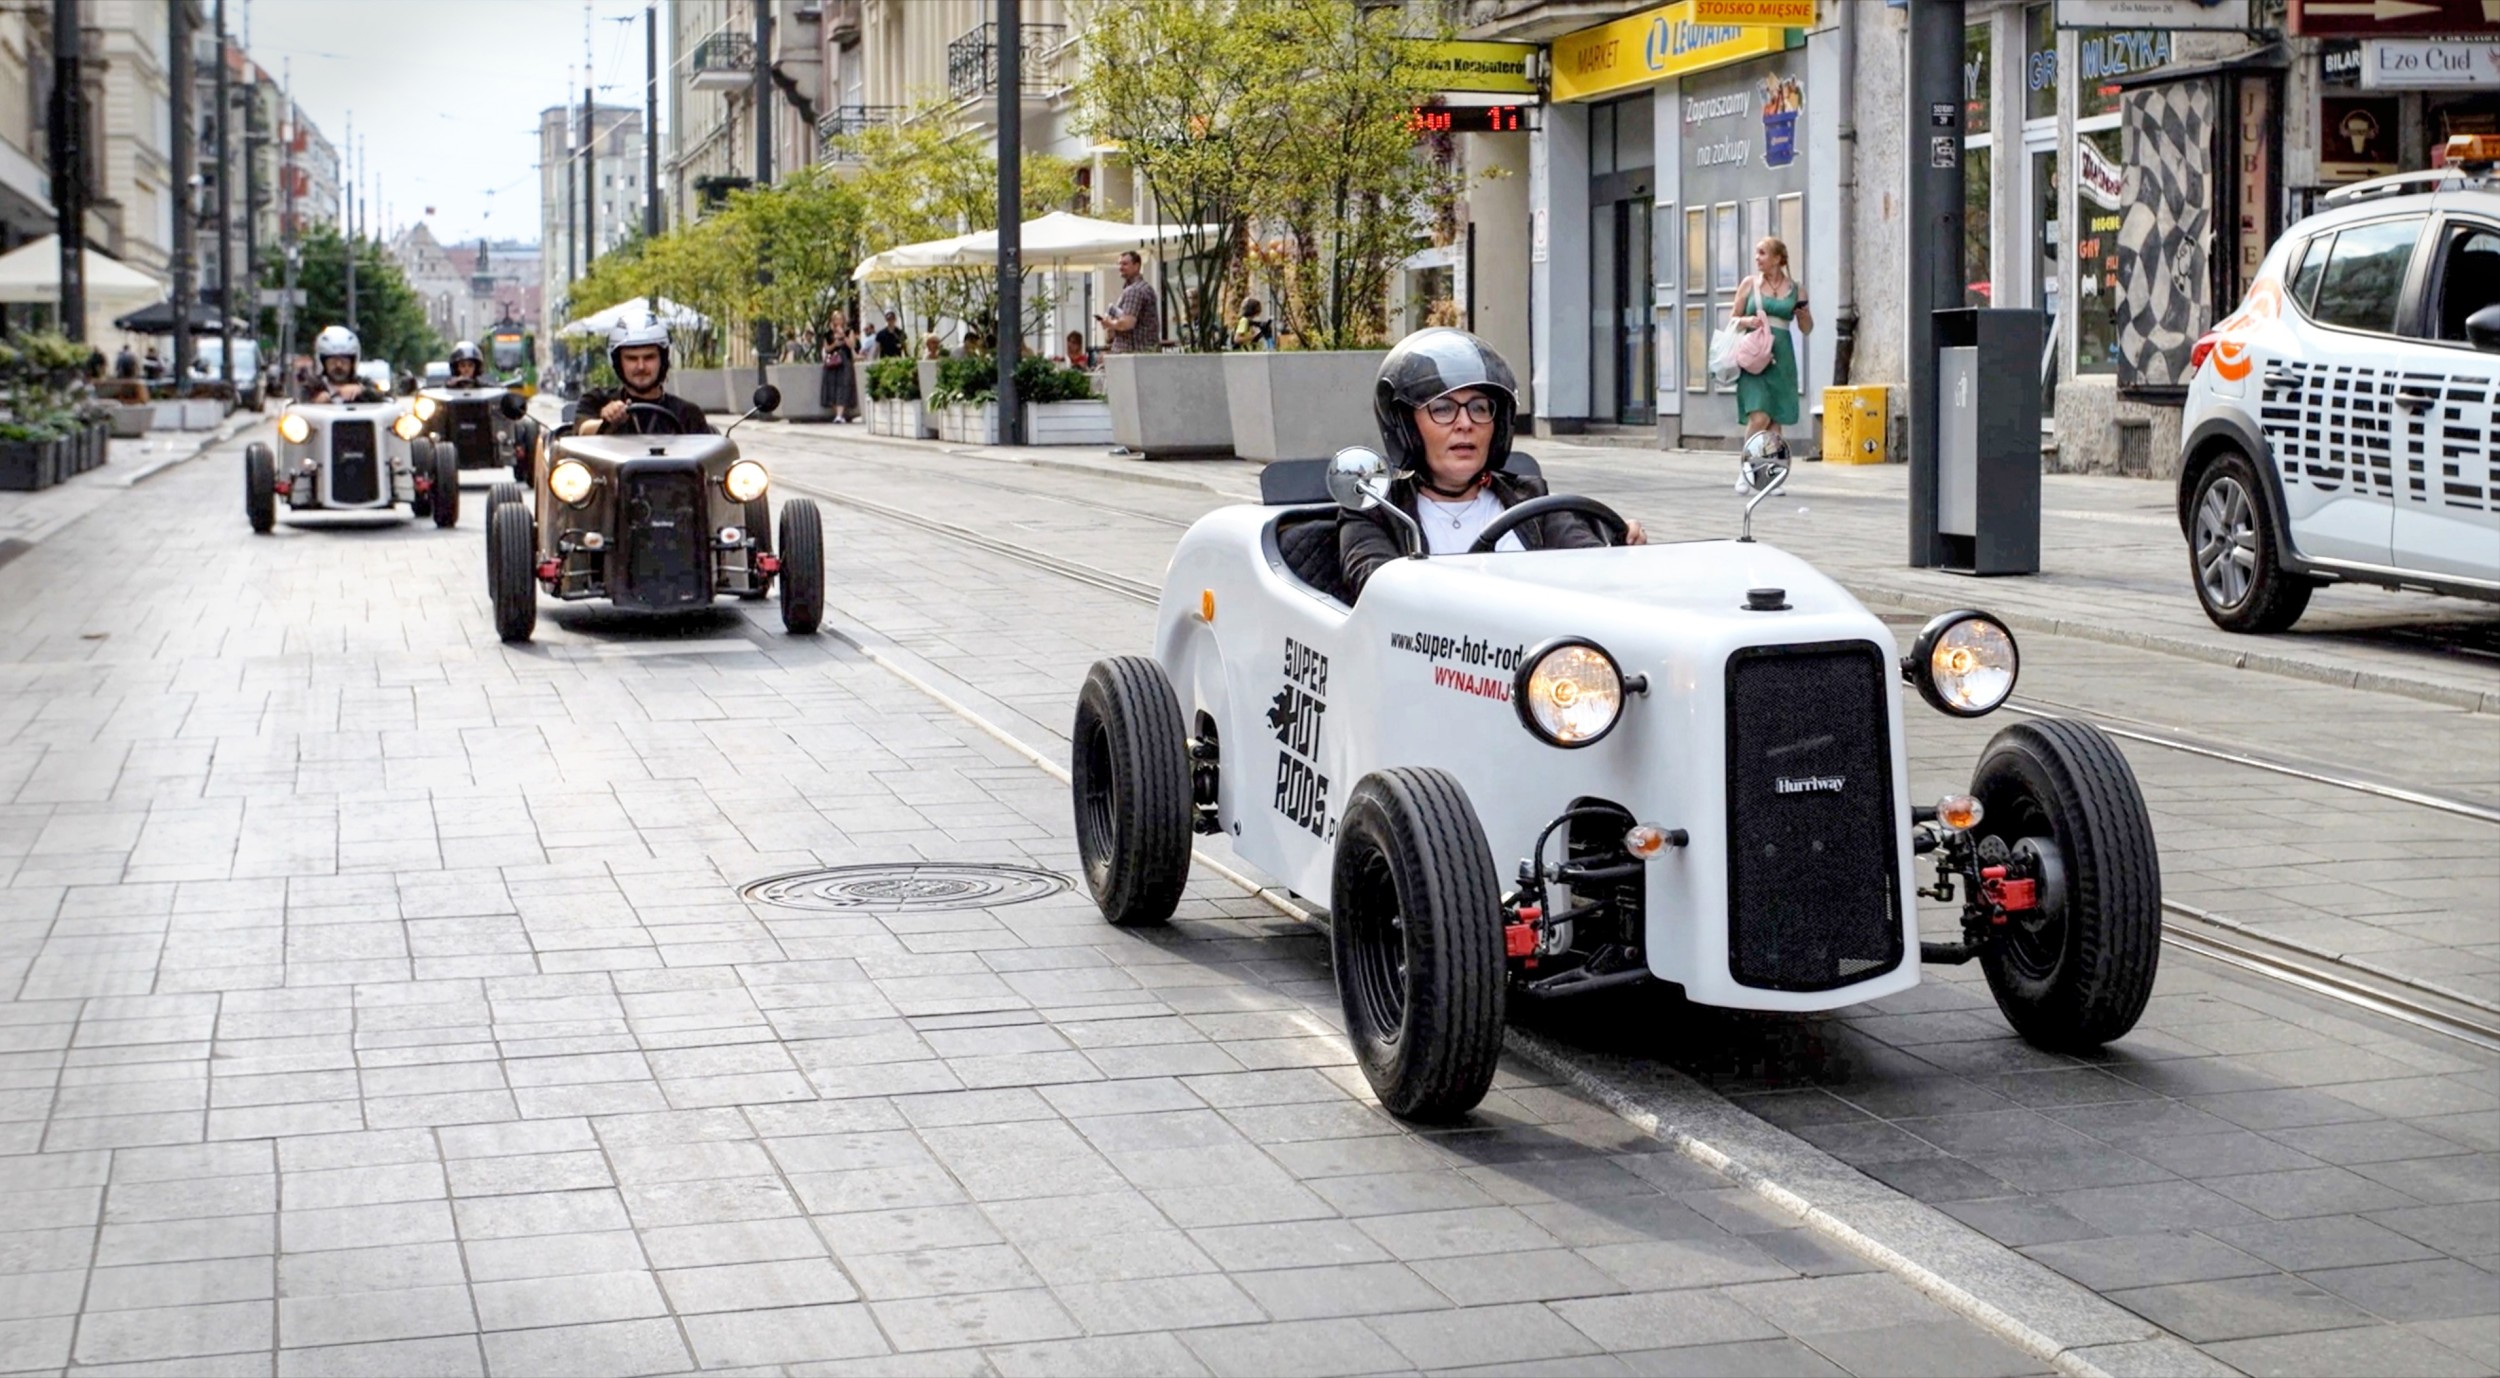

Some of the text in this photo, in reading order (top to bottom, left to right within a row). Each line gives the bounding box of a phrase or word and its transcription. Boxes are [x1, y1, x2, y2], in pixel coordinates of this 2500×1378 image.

[1696, 2, 1810, 18] STOISKO MIĘSNE
[1453, 58, 1526, 73] Komputeró
[1576, 40, 1619, 75] MARKET
[2082, 31, 2171, 79] MUZYKA
[2426, 46, 2470, 71] Cud
[1685, 91, 1750, 127] Zapraszamy
[1697, 135, 1751, 168] na zakupy
[2261, 358, 2500, 512] HUNTE
[1284, 636, 1329, 697] SUPER
[1391, 631, 1528, 672] www.super-hot-rod
[1776, 776, 1846, 793] Hurriway
